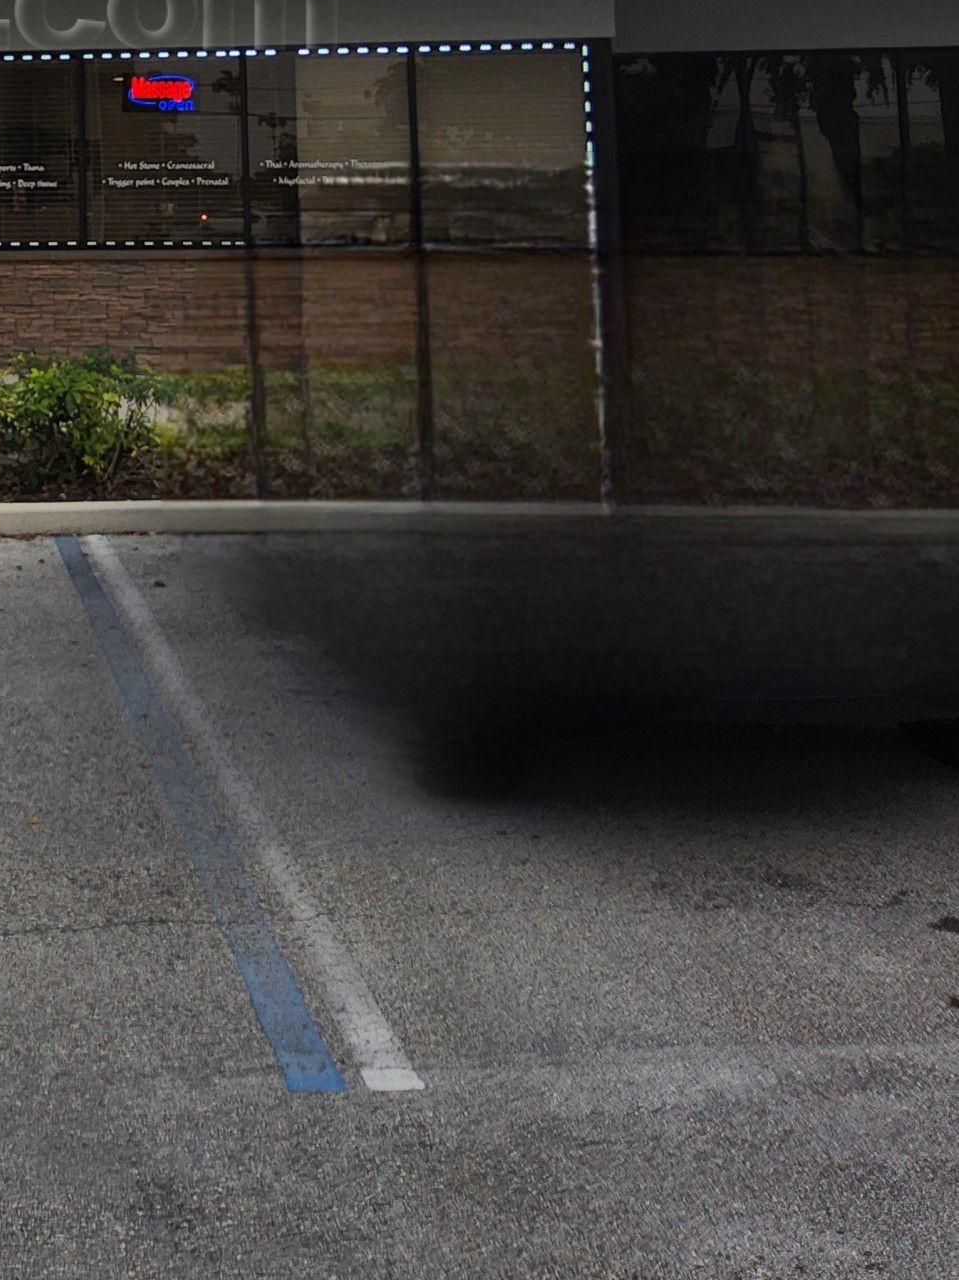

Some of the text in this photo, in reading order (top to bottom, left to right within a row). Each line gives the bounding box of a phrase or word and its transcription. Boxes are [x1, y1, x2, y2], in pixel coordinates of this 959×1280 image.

[131, 76, 192, 102] Massage
[139, 160, 160, 170] Stone
[264, 159, 283, 168] Thai
[17, 179, 36, 189] Deep
[107, 176, 229, 188] Trigger point Couples Prenatal
